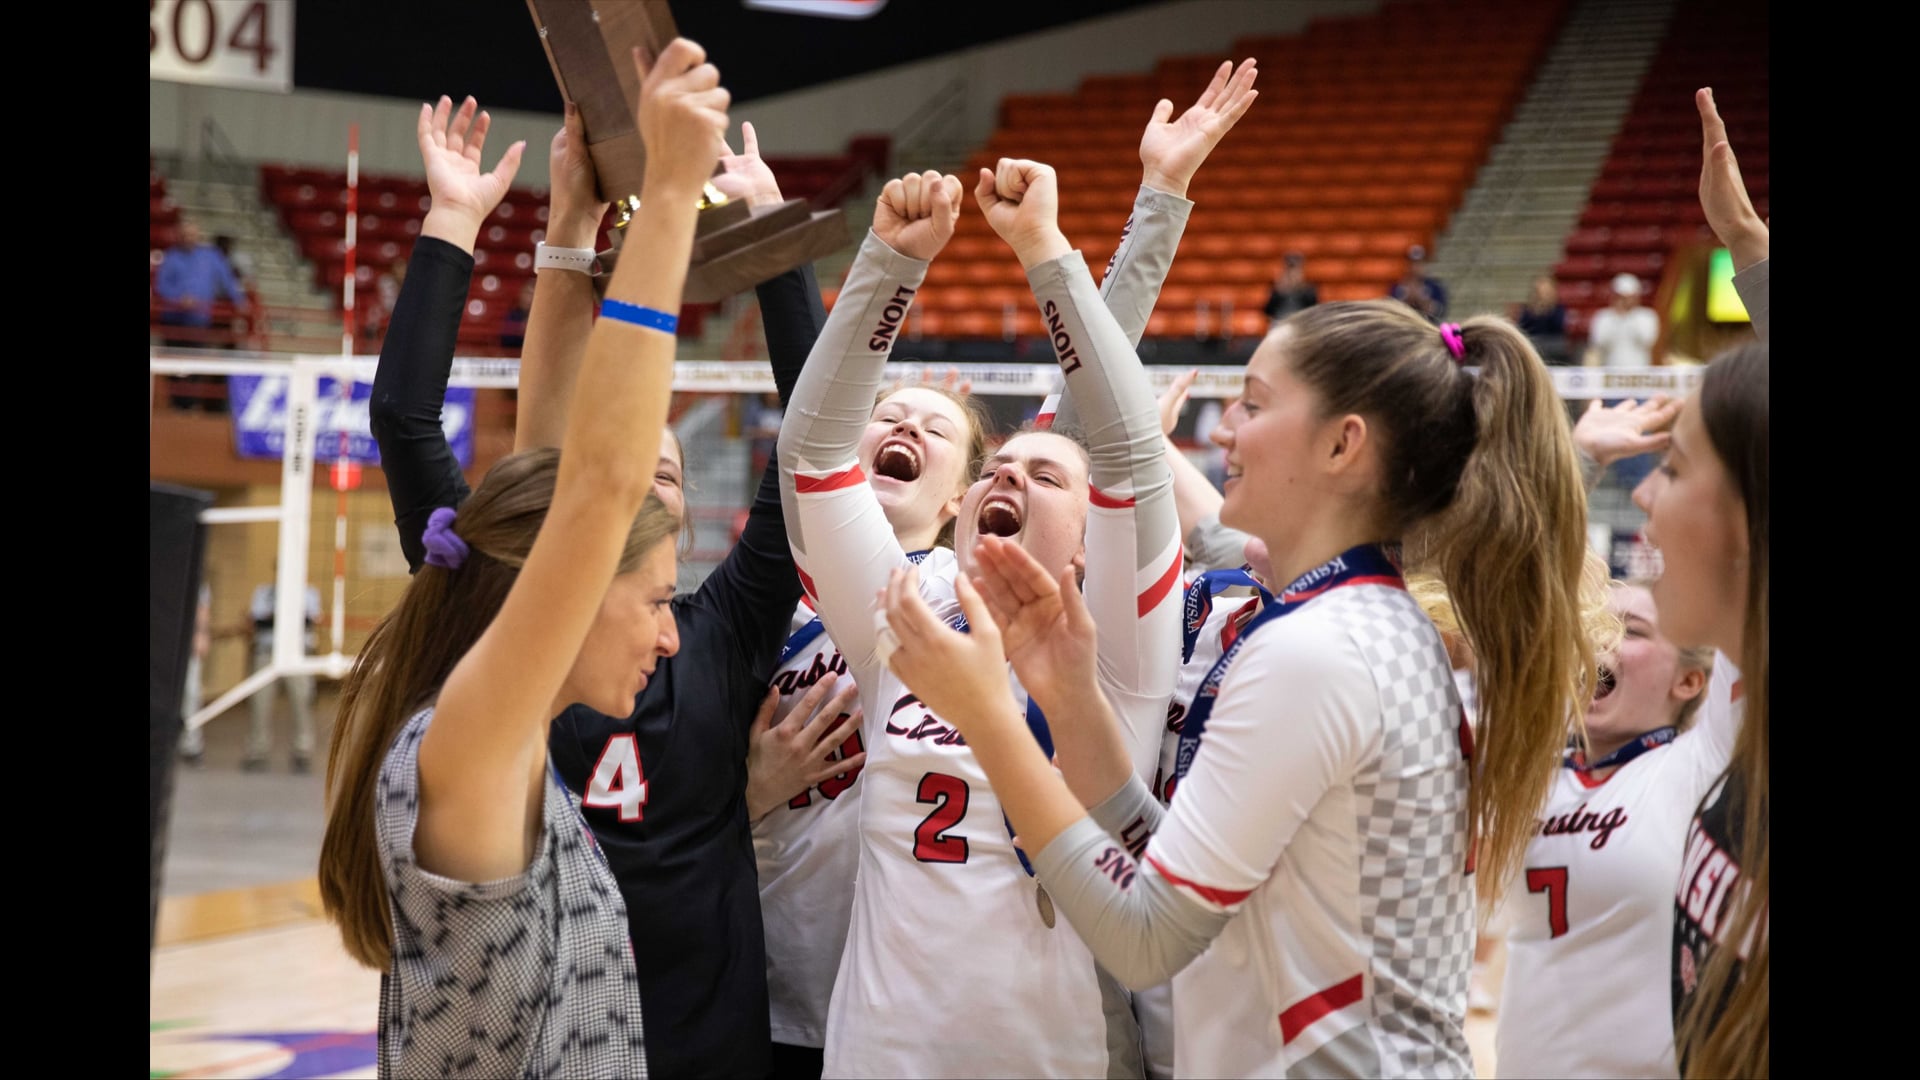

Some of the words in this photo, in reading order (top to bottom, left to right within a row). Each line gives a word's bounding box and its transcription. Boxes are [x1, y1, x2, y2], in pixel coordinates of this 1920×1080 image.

[150, 0, 278, 75] 04
[868, 284, 916, 353] LIONS
[1043, 299, 1083, 377] LIONS
[1186, 575, 1207, 635] KSHSAA
[582, 731, 649, 824] 4
[912, 770, 970, 865] 2
[1525, 865, 1570, 940] 7
